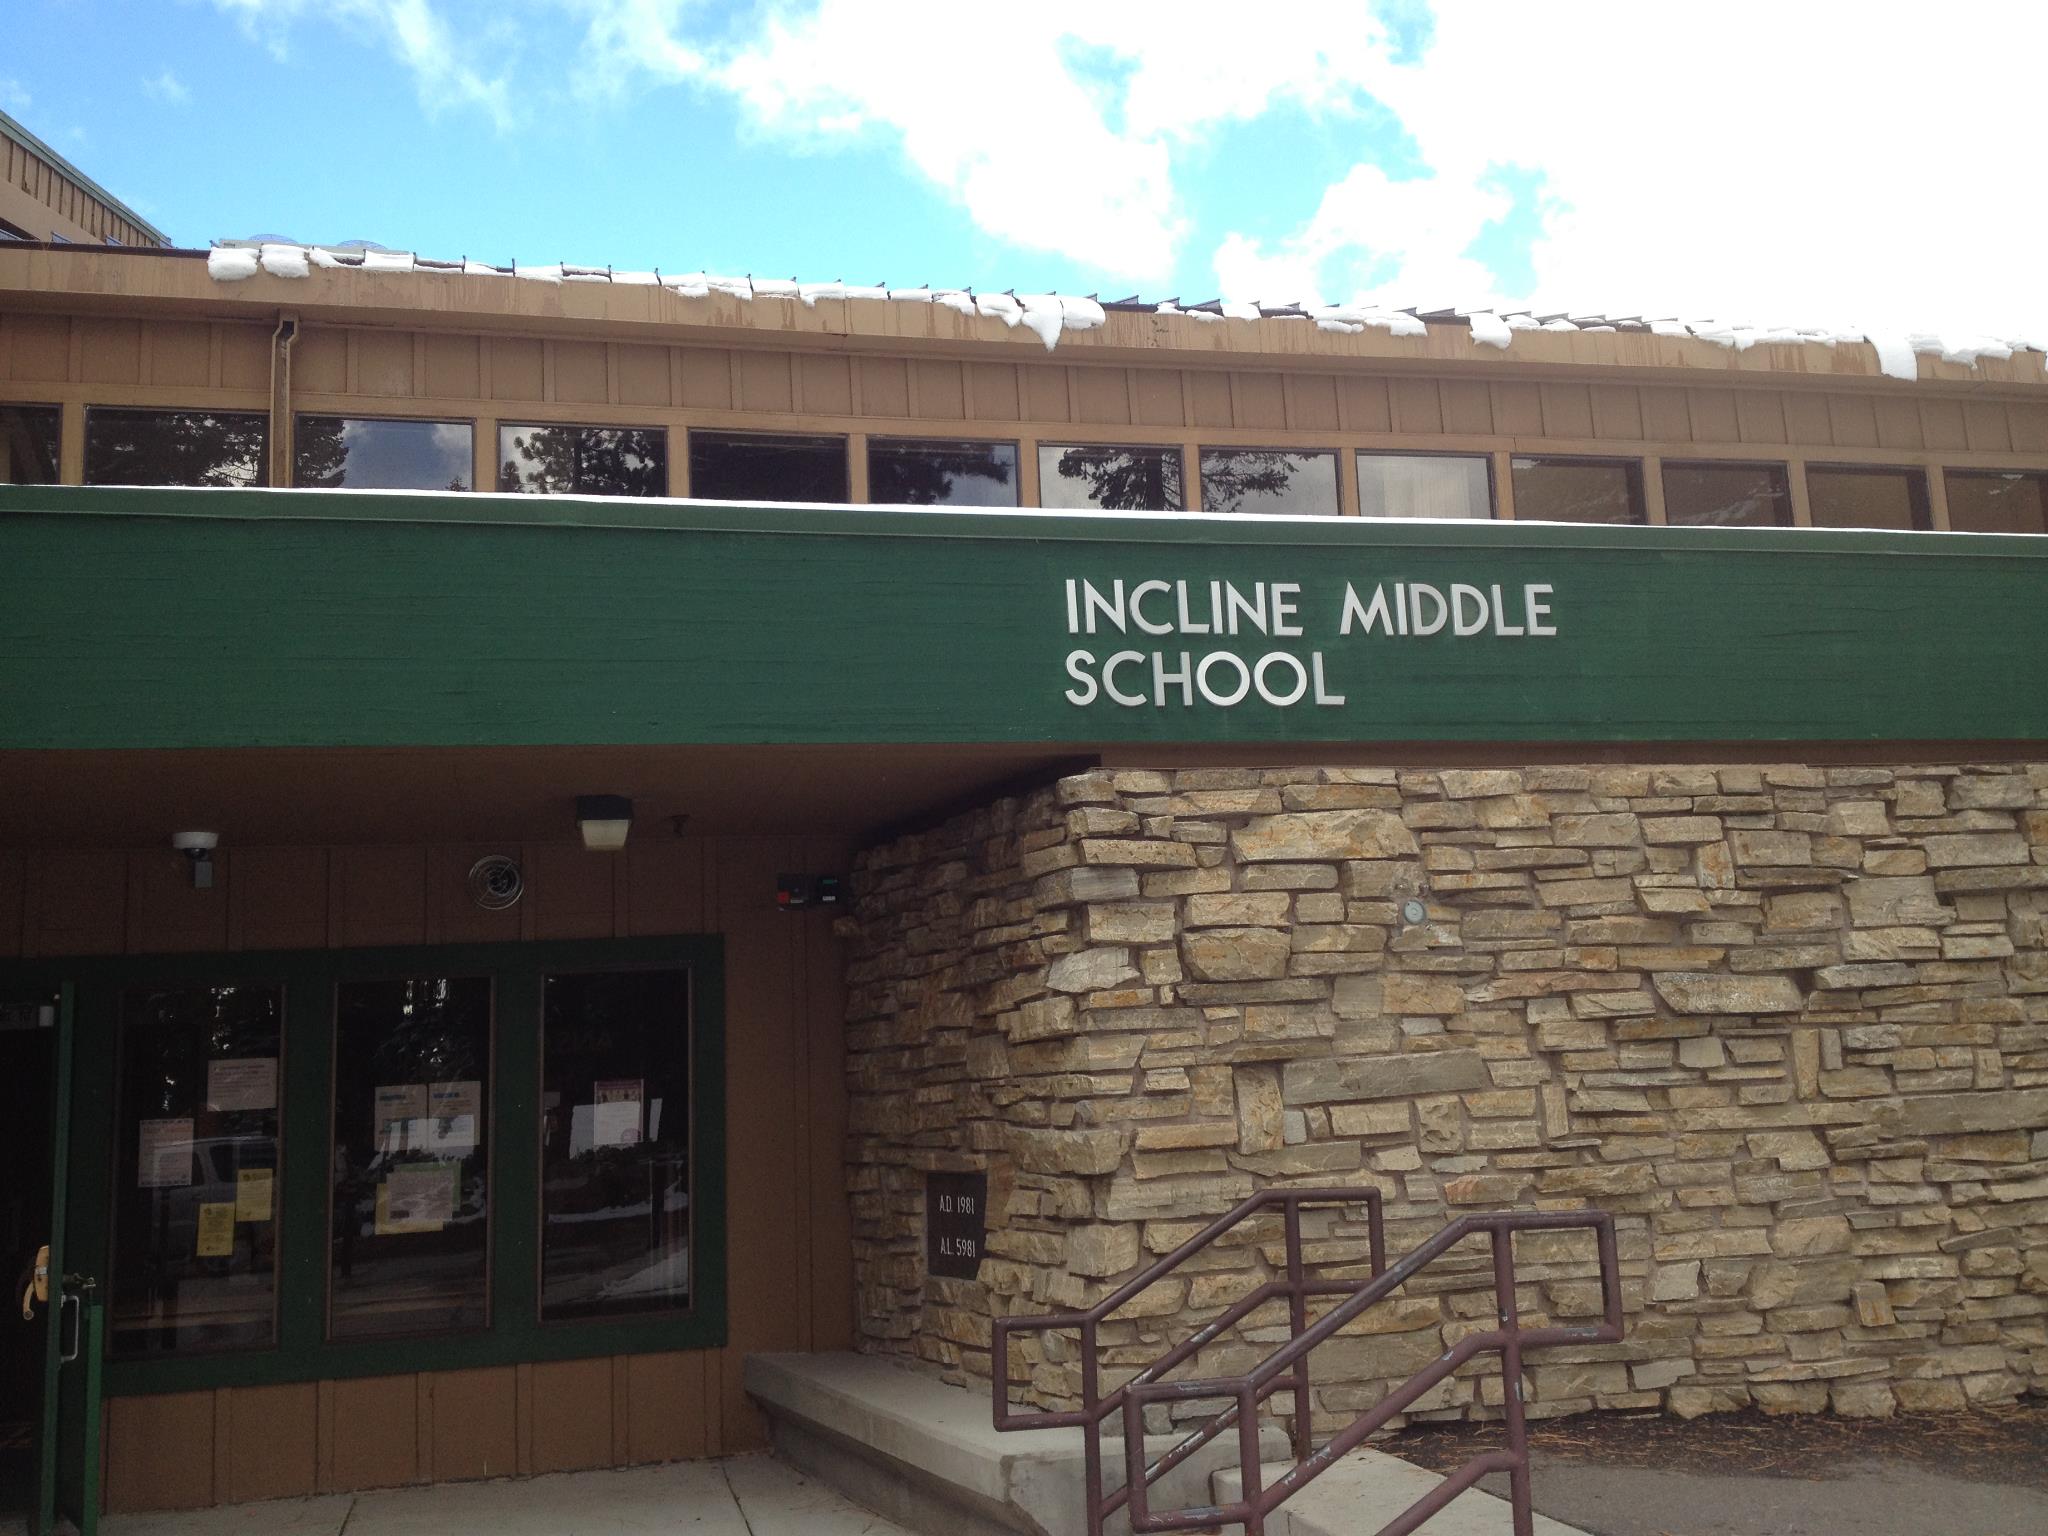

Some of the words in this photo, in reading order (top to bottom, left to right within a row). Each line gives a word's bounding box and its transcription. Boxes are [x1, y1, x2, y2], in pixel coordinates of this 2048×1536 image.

[1065, 578, 1304, 637] INCLINE
[1339, 581, 1558, 637] MIDDLE
[1064, 649, 1346, 707] SCHOOL
[957, 1196, 975, 1215] 1981
[956, 1238, 975, 1258] 5981
